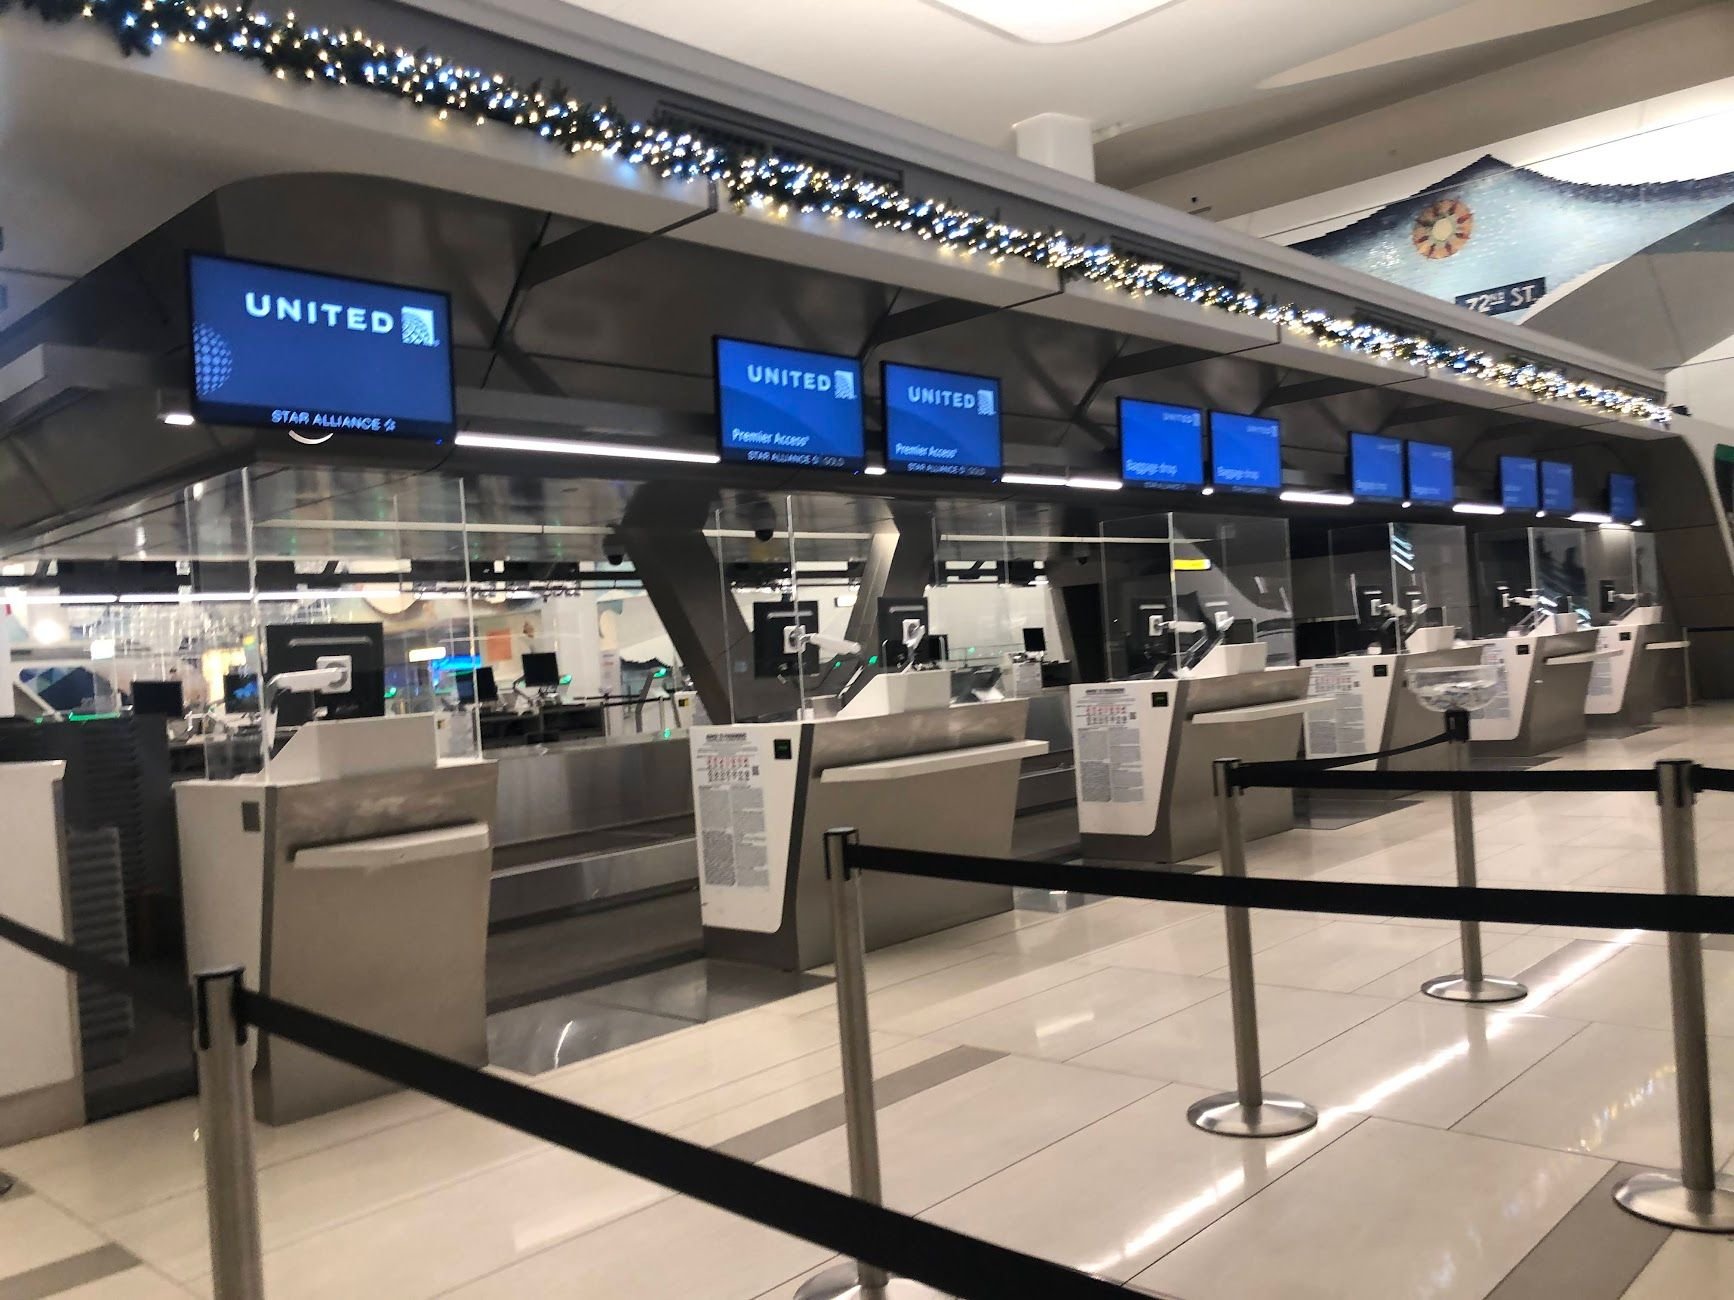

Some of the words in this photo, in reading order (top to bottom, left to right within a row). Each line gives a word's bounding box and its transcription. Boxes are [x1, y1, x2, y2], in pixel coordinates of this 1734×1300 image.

[245, 292, 395, 334] UNITED
[747, 365, 832, 392] UNITED
[908, 386, 976, 409] UNITED
[272, 409, 309, 424] STAR
[312, 413, 381, 431] ALLIANCE
[732, 427, 773, 444] Premier
